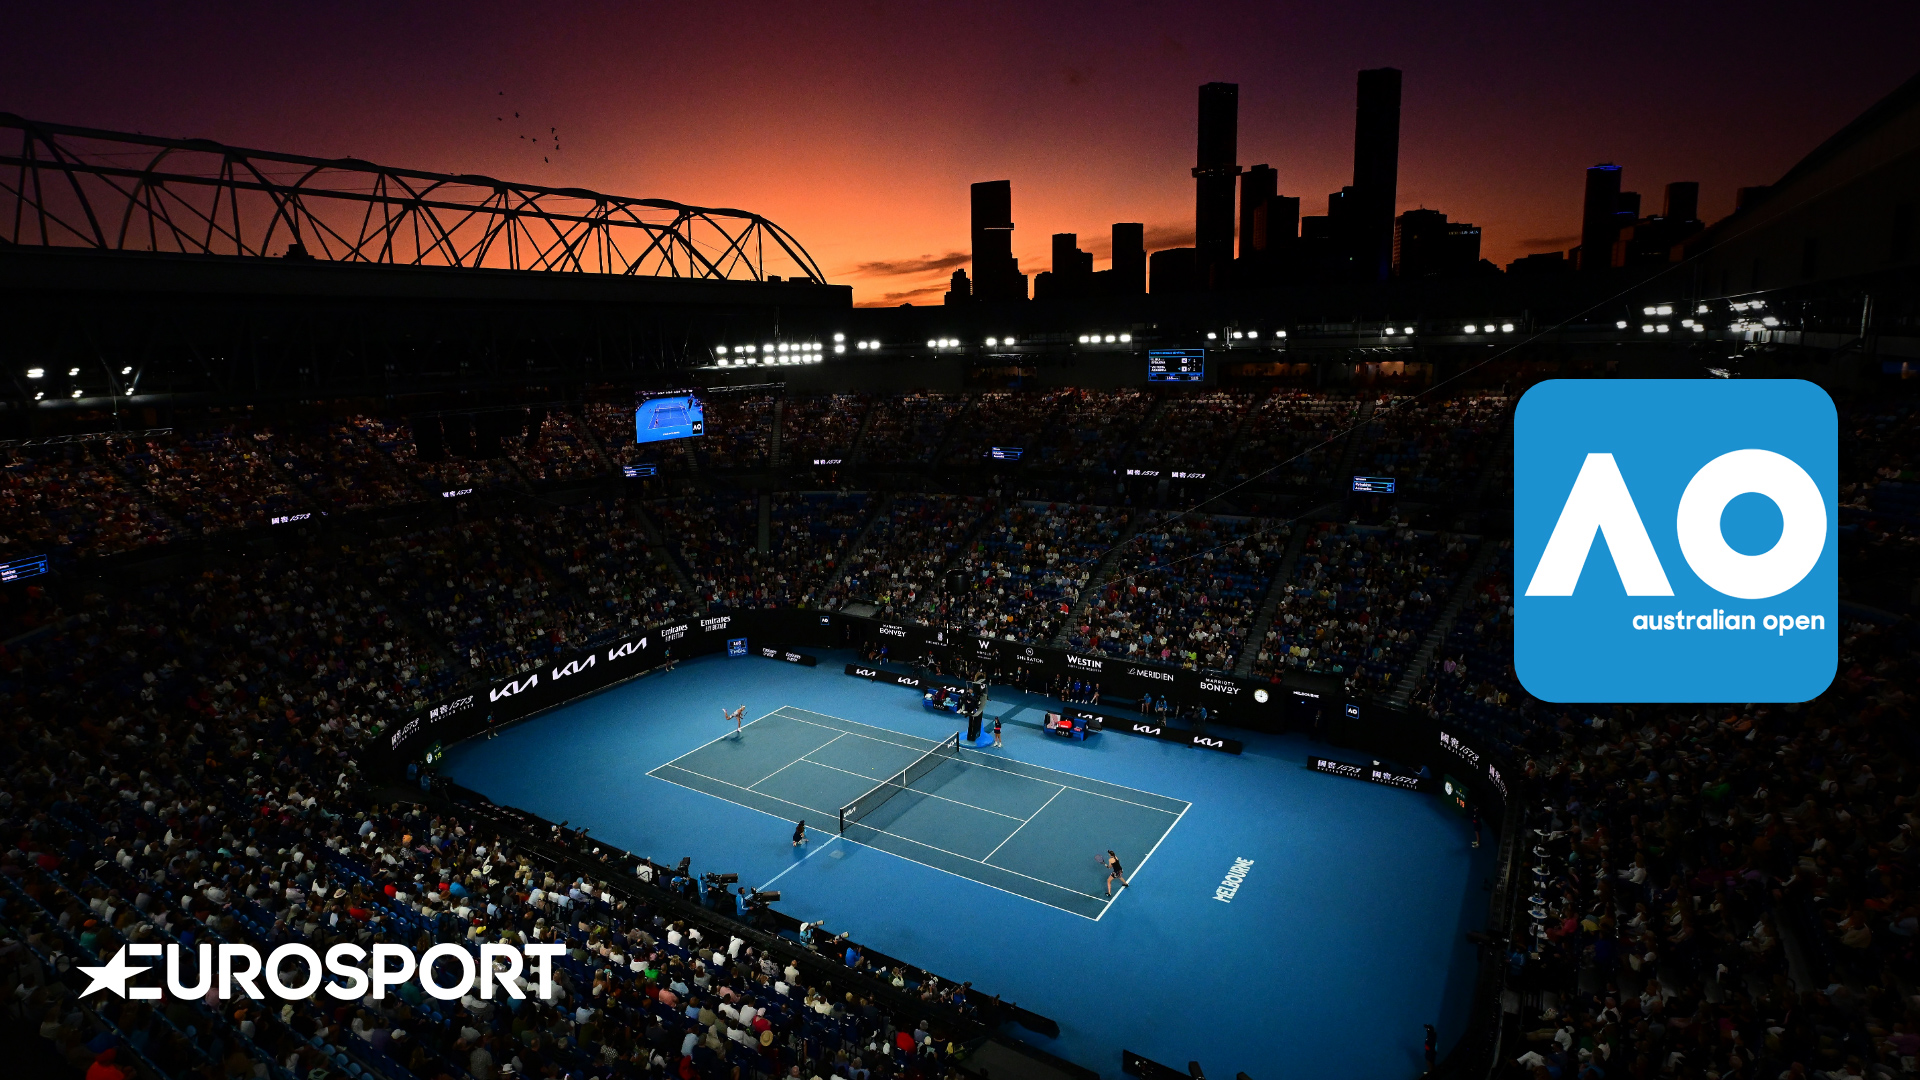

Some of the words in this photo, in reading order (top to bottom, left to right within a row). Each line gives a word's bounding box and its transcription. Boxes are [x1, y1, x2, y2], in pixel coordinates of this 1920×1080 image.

[700, 615, 731, 627] Emirates
[661, 623, 688, 638] Emirates
[880, 627, 907, 637] BONVOY
[608, 637, 647, 661] KIA
[978, 639, 990, 650] W
[552, 654, 596, 681] KIA
[1066, 654, 1102, 669] WESTIN
[490, 673, 538, 702] KIA
[1200, 682, 1240, 695] BONVOY
[1205, 678, 1234, 687] MARRIOTT
[1212, 856, 1255, 904] MELBOURNE
